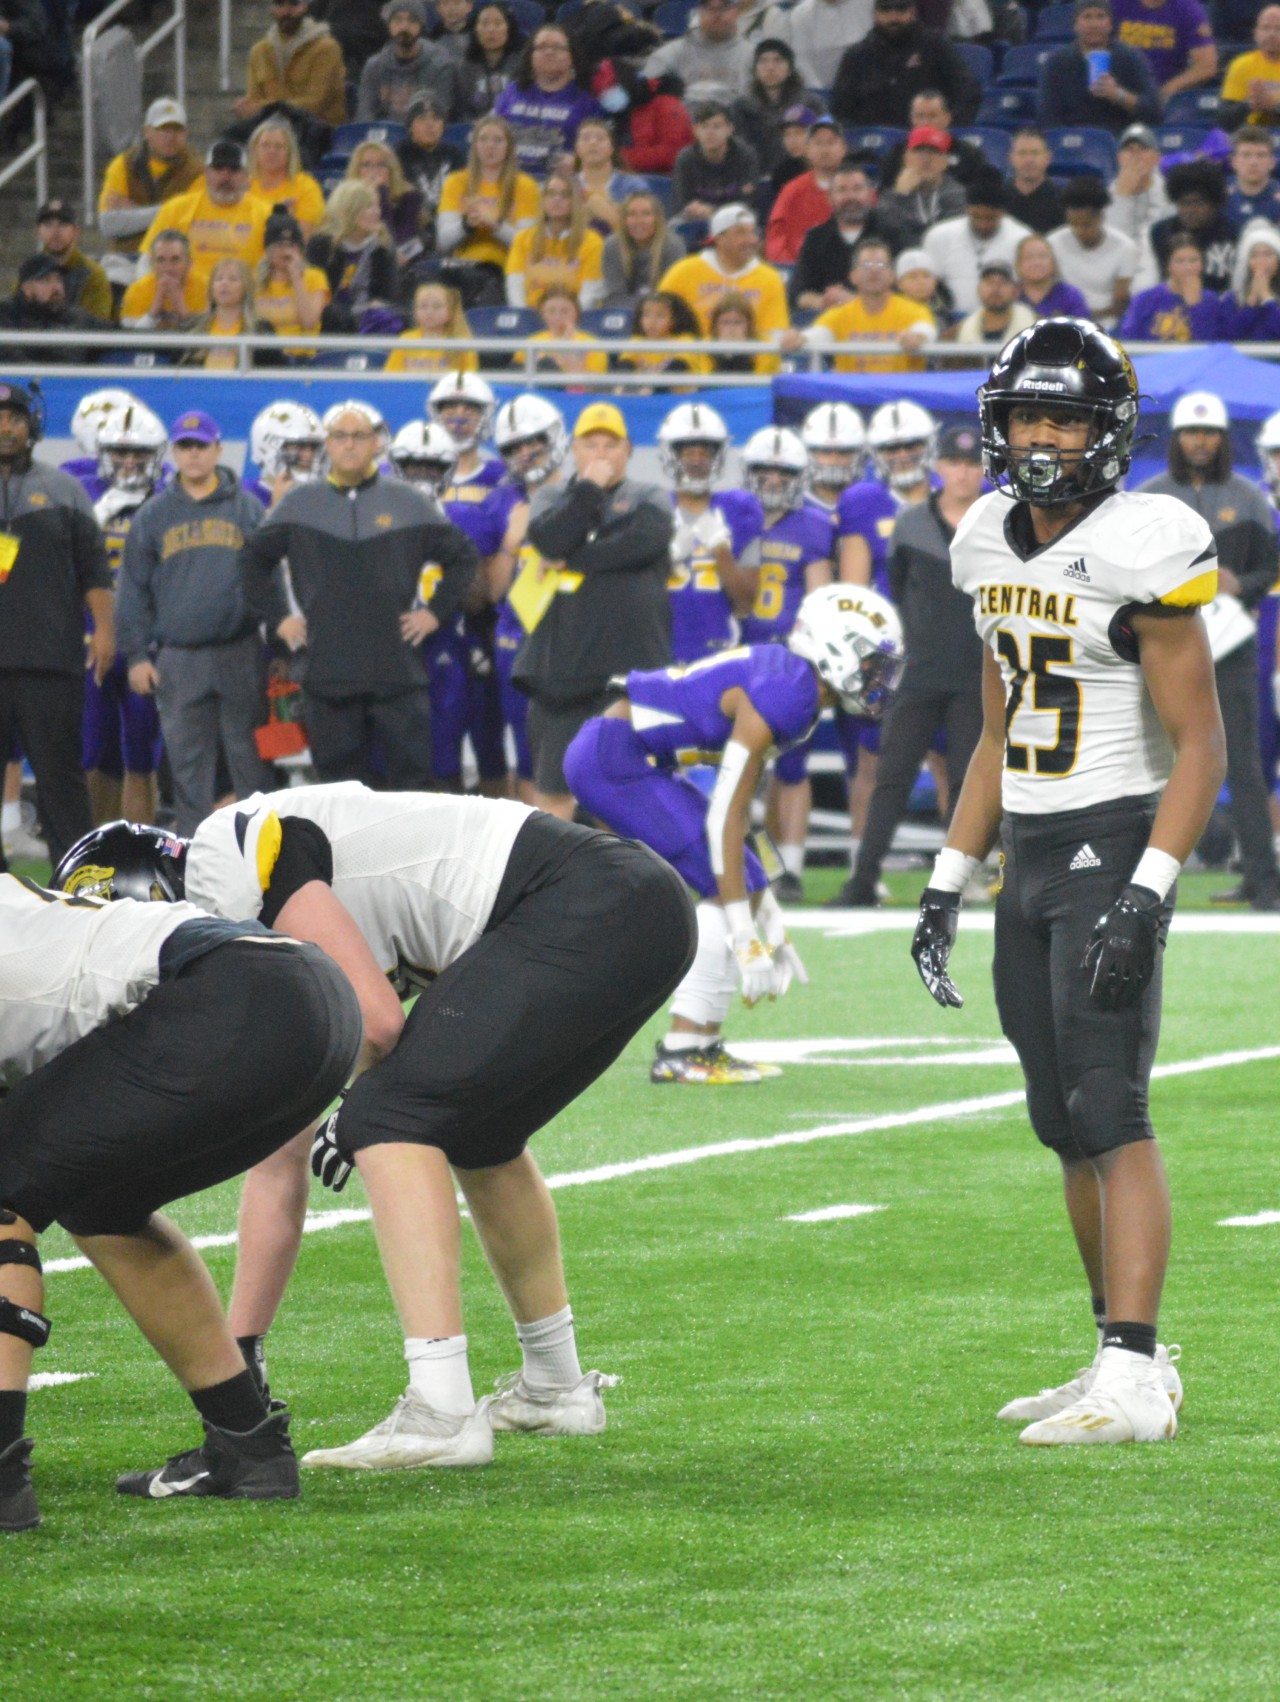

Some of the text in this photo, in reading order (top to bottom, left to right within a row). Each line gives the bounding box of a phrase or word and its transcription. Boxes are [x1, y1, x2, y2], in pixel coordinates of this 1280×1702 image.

[1022, 379, 1063, 392] Riddell
[1063, 569, 1091, 583] adidas
[837, 598, 888, 629] DLS
[979, 584, 1078, 626] CENTRAL
[996, 627, 1083, 777] 25
[1069, 858, 1101, 870] adidas
